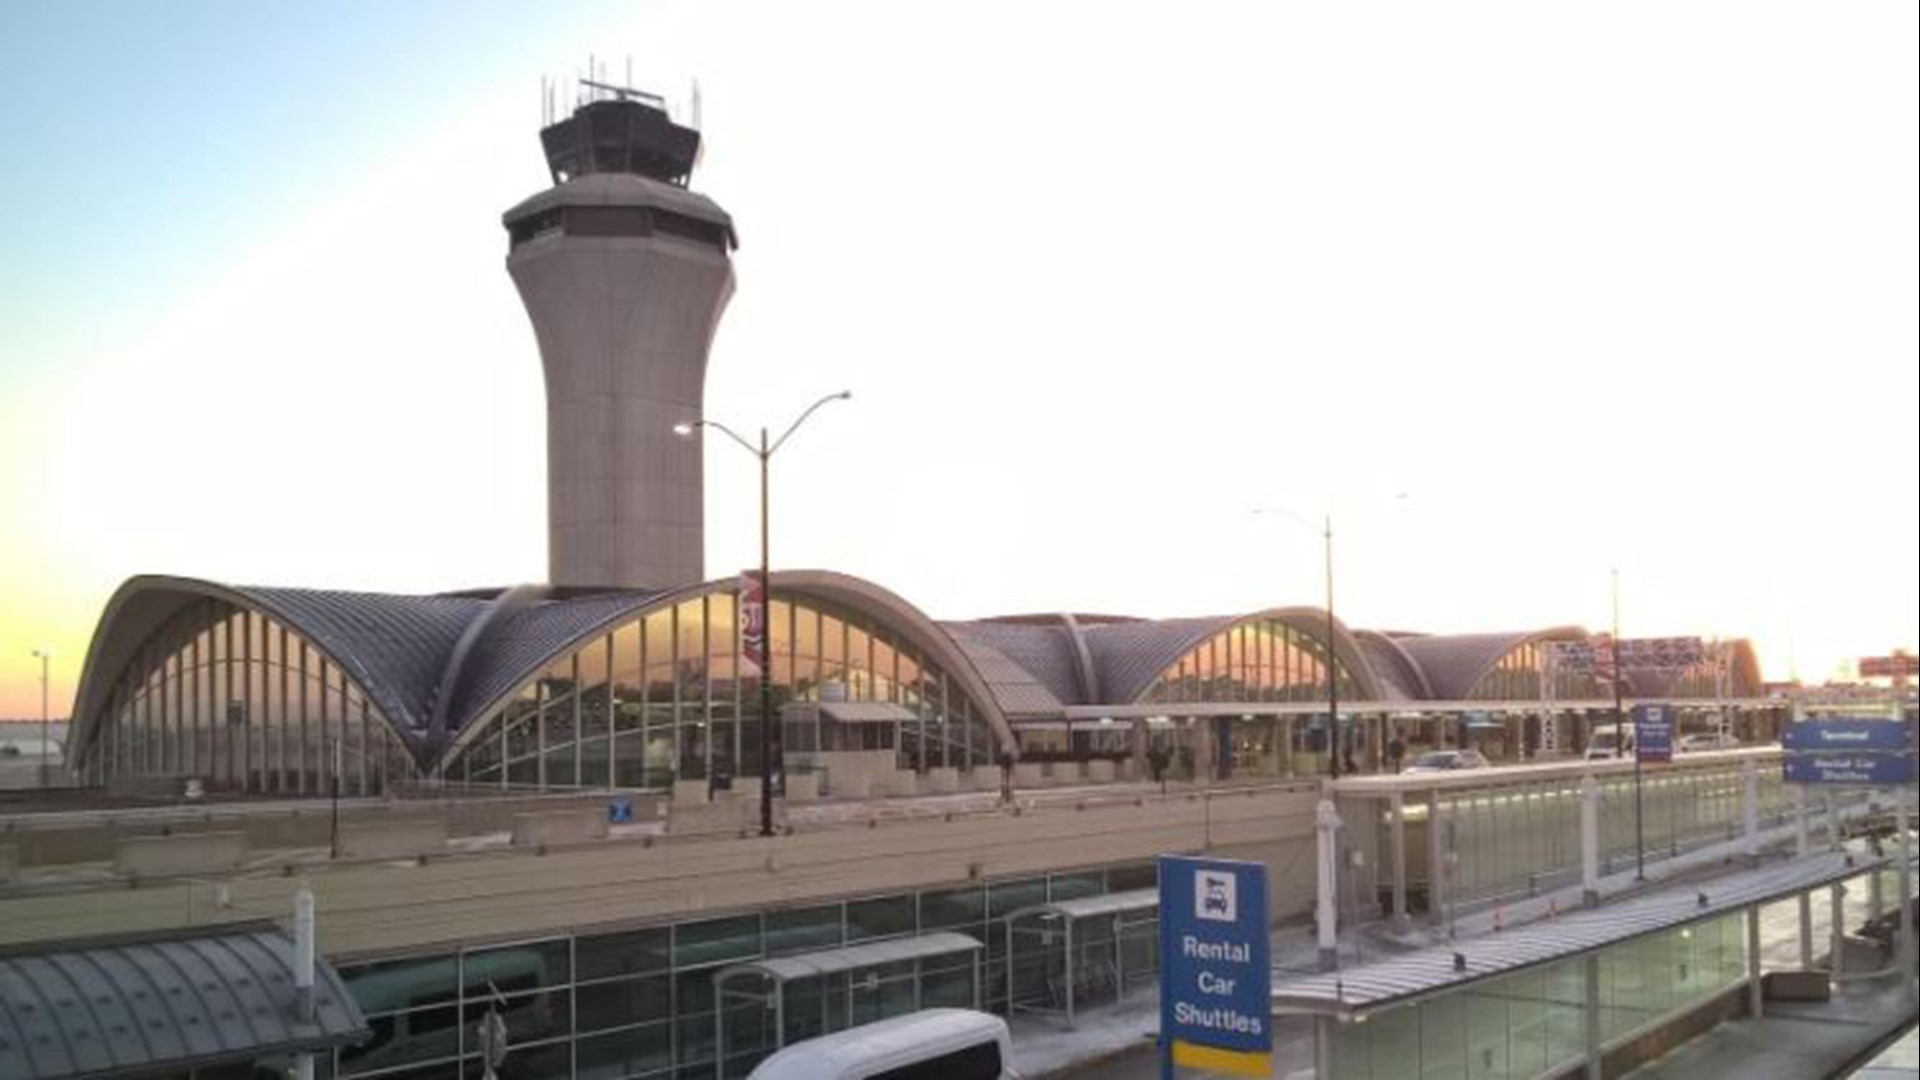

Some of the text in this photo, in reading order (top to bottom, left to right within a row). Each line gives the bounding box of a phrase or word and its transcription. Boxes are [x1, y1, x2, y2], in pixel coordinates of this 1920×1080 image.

[1183, 935, 1250, 962] Rental
[1198, 971, 1235, 995] Car
[1174, 1002, 1262, 1034] Shuttles
